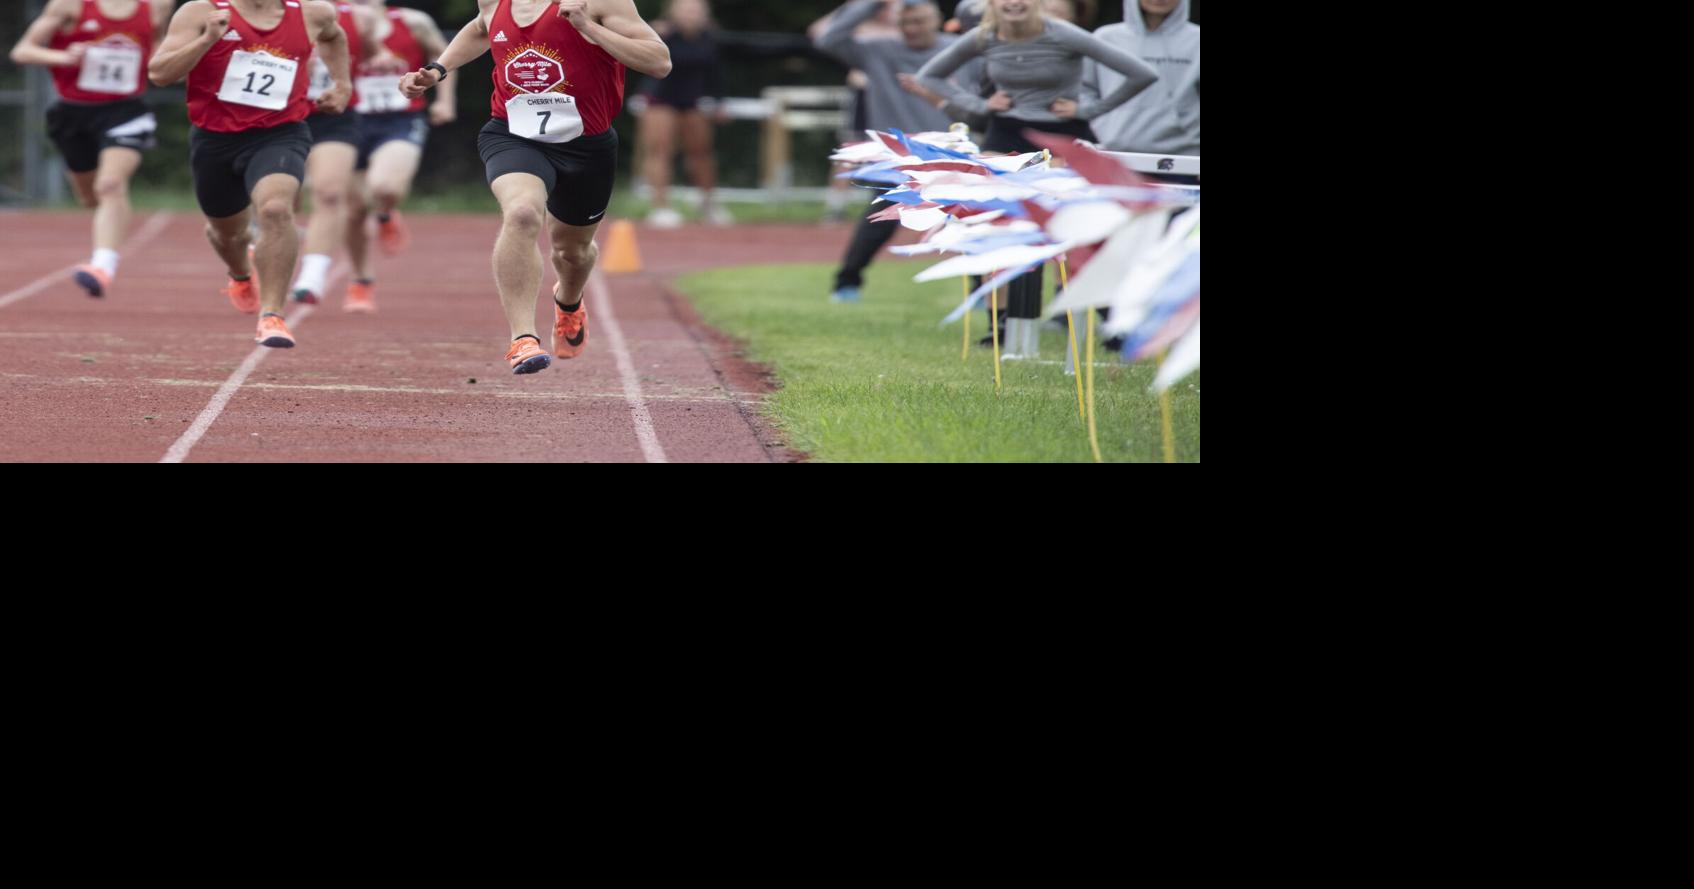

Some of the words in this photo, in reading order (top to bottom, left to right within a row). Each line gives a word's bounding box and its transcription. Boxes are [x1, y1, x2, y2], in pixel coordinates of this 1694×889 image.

[252, 59, 277, 68] CHERRY
[242, 71, 275, 96] 12
[527, 98, 553, 106] CHERRY
[537, 110, 551, 135] 7
